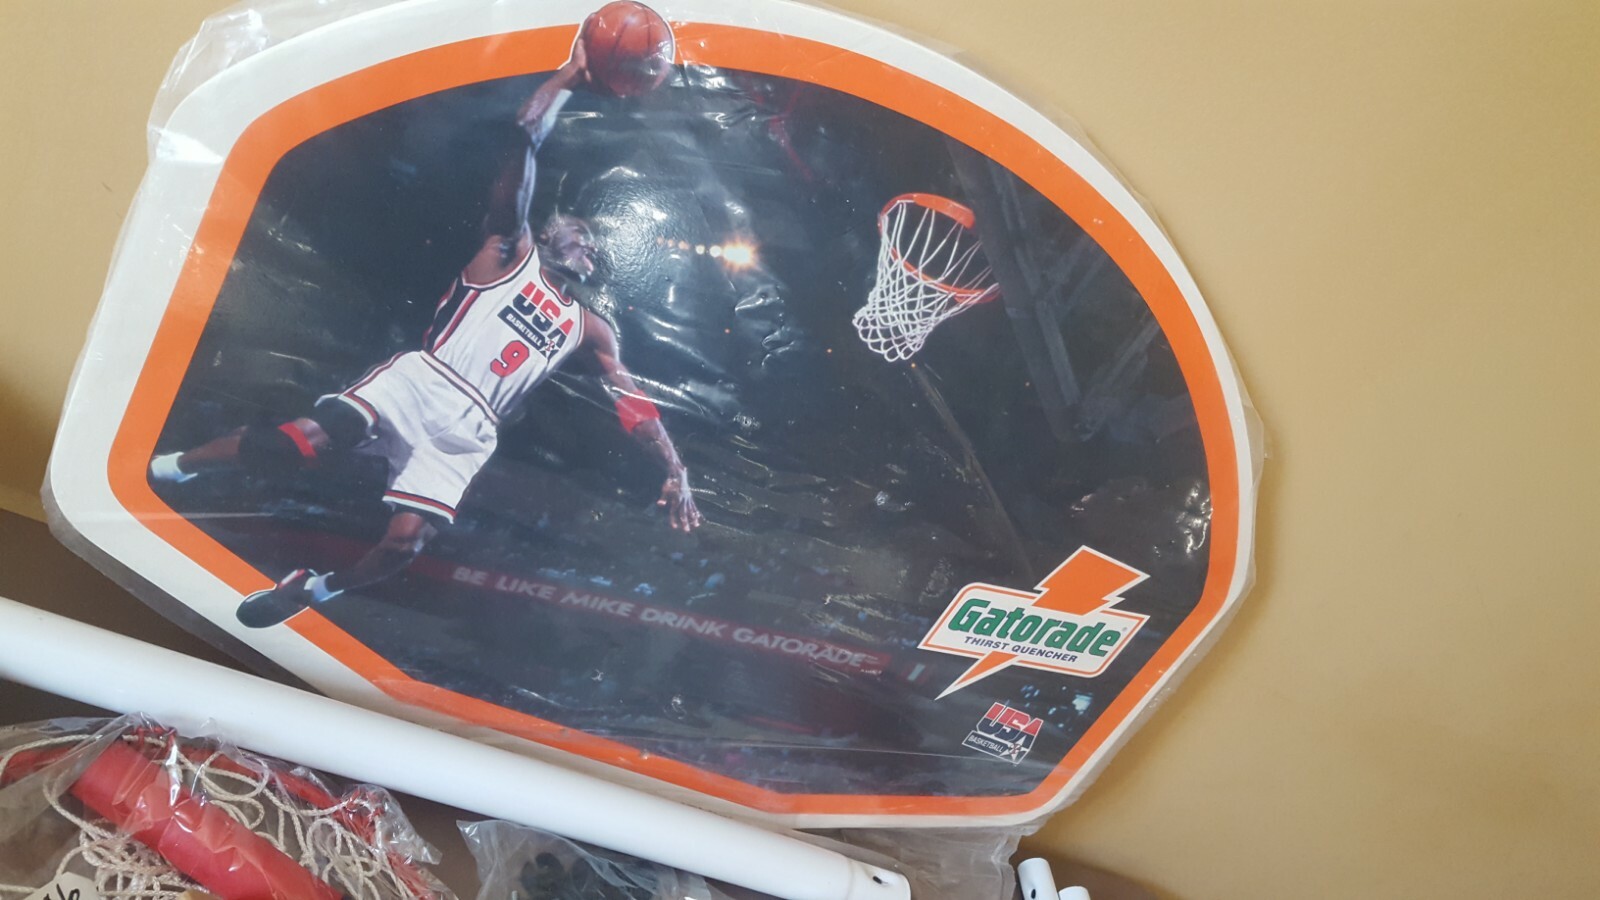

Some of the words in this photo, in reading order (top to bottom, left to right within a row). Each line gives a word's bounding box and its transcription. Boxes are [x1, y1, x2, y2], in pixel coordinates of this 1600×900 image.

[505, 312, 543, 347] BASKETBALL
[513, 281, 574, 351] USA
[490, 340, 530, 377] 9
[452, 566, 489, 586] BE
[494, 575, 557, 600] LIKE
[559, 592, 636, 617] MIKE
[639, 608, 728, 638] DRINK
[732, 627, 868, 668] GATORADE
[947, 598, 1121, 657] Gatorade
[964, 636, 1010, 650] THIRST
[1011, 643, 1078, 663] QUENCHER
[967, 734, 1005, 753] BASKETBALL
[976, 702, 1044, 750] USA
